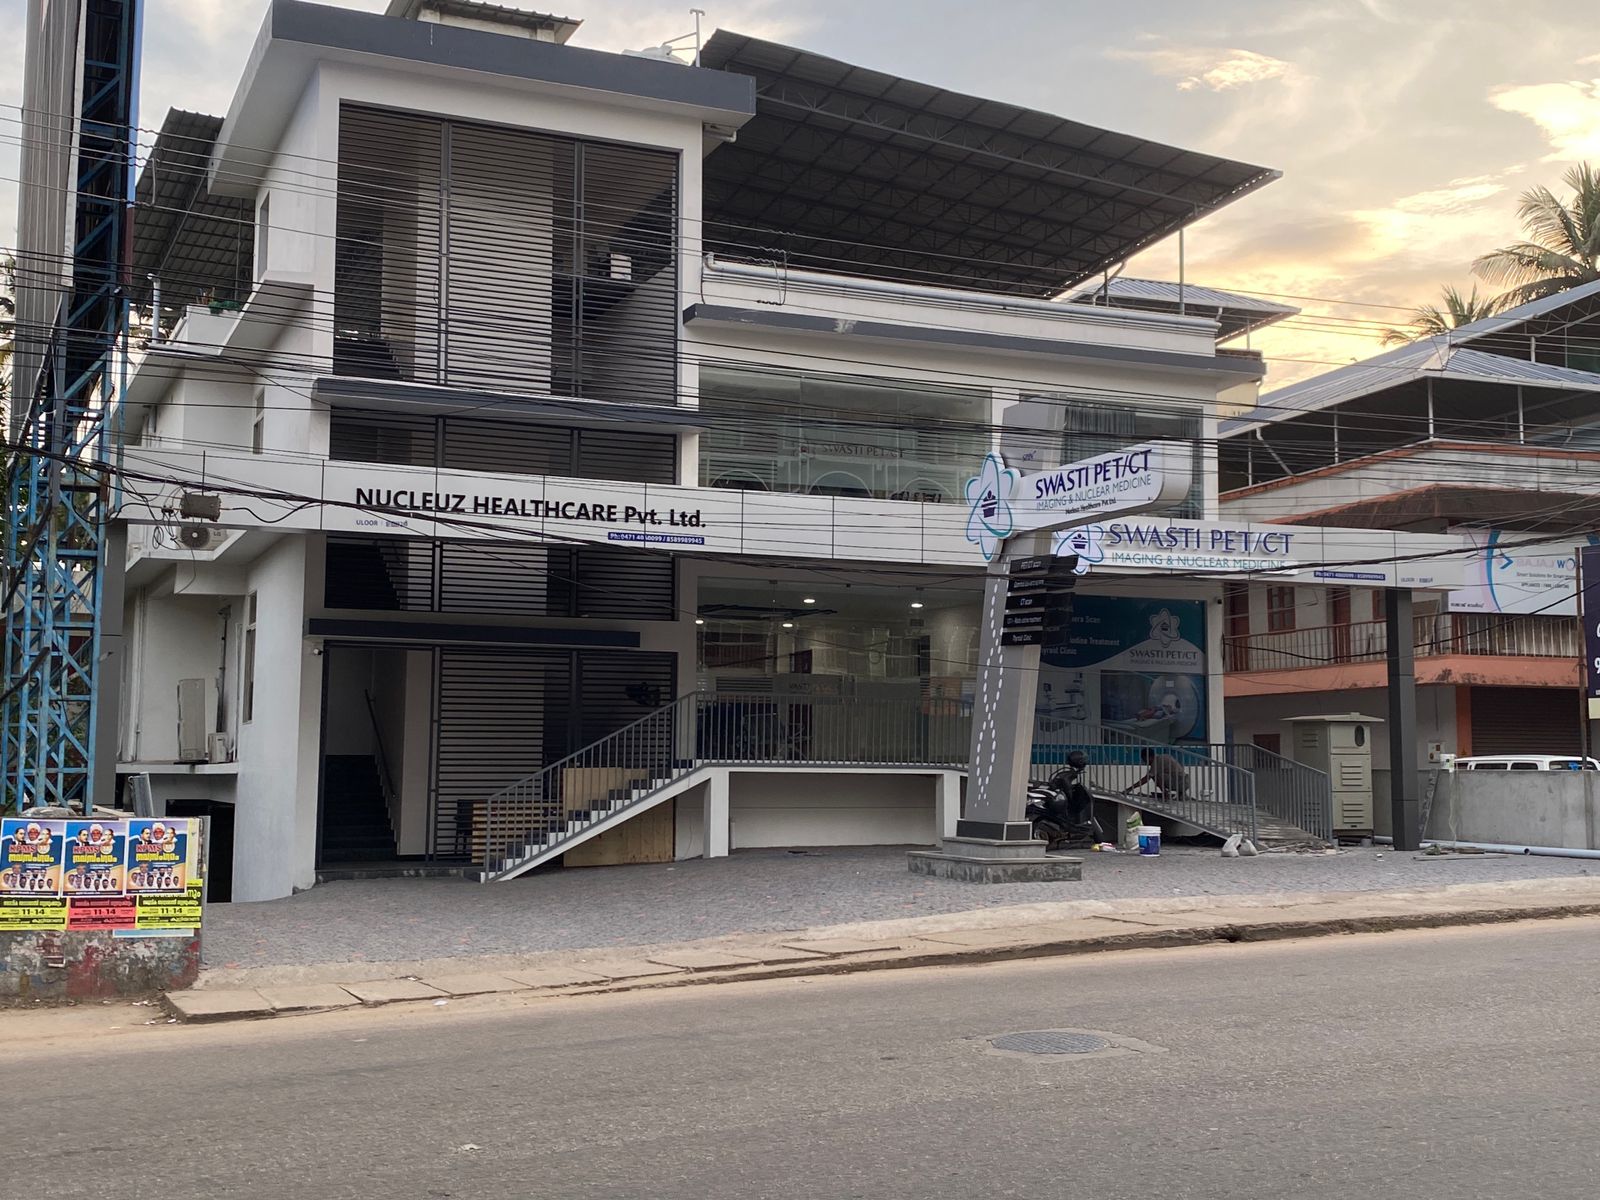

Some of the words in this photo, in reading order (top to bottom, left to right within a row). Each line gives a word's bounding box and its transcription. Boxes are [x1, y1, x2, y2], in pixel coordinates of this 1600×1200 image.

[1036, 466, 1088, 499] SWASTI
[1095, 449, 1152, 484] PET/CT
[356, 488, 466, 512] NUCLEUZ
[474, 496, 617, 522] HEALTHCARE
[624, 505, 662, 525] Pvt.
[670, 509, 706, 528] Ltd.
[1037, 493, 1067, 511] IMAGING
[1069, 495, 1074, 504] &
[1075, 484, 1110, 501] NUCLEAR
[1112, 474, 1151, 493] MEDICINE
[1109, 523, 1199, 549] SWASTI
[1211, 529, 1294, 554] PET/CT
[1112, 552, 1163, 565] IMAGING
[1166, 555, 1174, 566] &
[1177, 555, 1230, 568] NUCLEAR
[1233, 559, 1286, 570] MEDICINE
[1129, 649, 1163, 659] SWASTI
[1166, 651, 1198, 660] PET/CT
